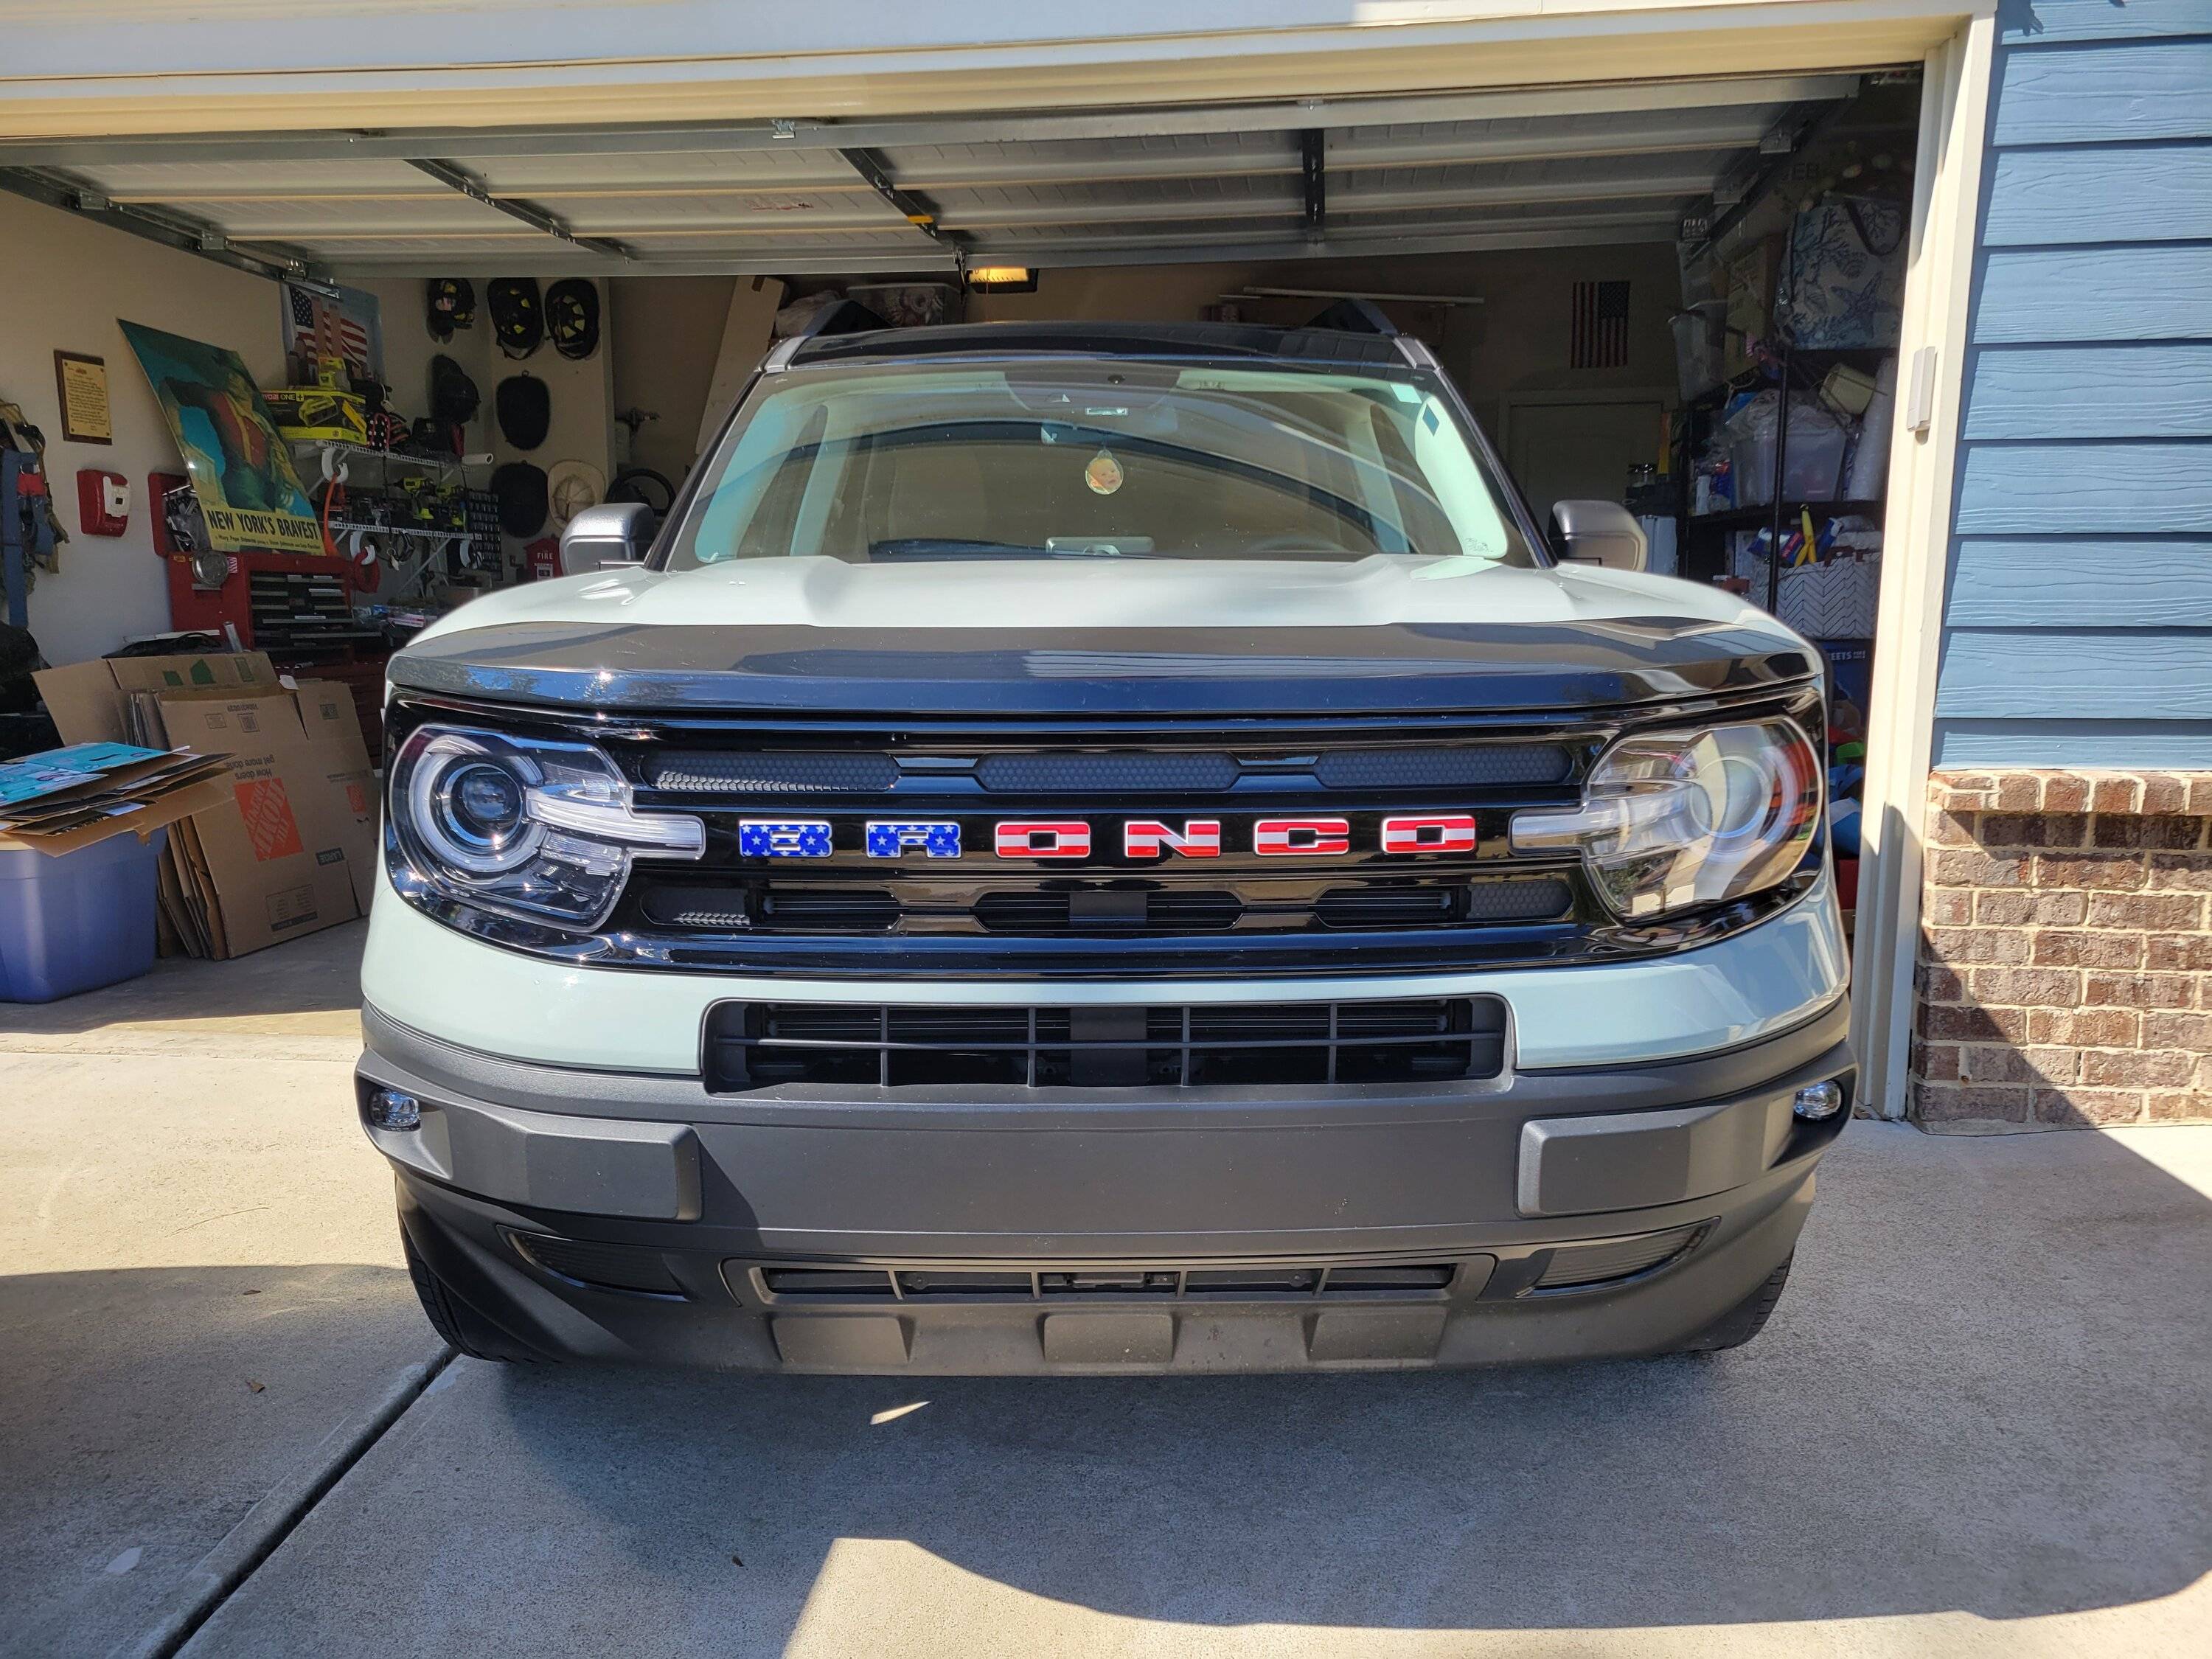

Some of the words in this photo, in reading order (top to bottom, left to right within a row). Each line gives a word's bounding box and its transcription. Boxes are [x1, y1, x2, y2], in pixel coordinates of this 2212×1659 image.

[263, 393, 279, 401] YOBI
[207, 509, 235, 532] NEW
[236, 513, 276, 535] YORK'S
[276, 518, 319, 540] BRAVEST
[739, 815, 1475, 858] BRONCO
